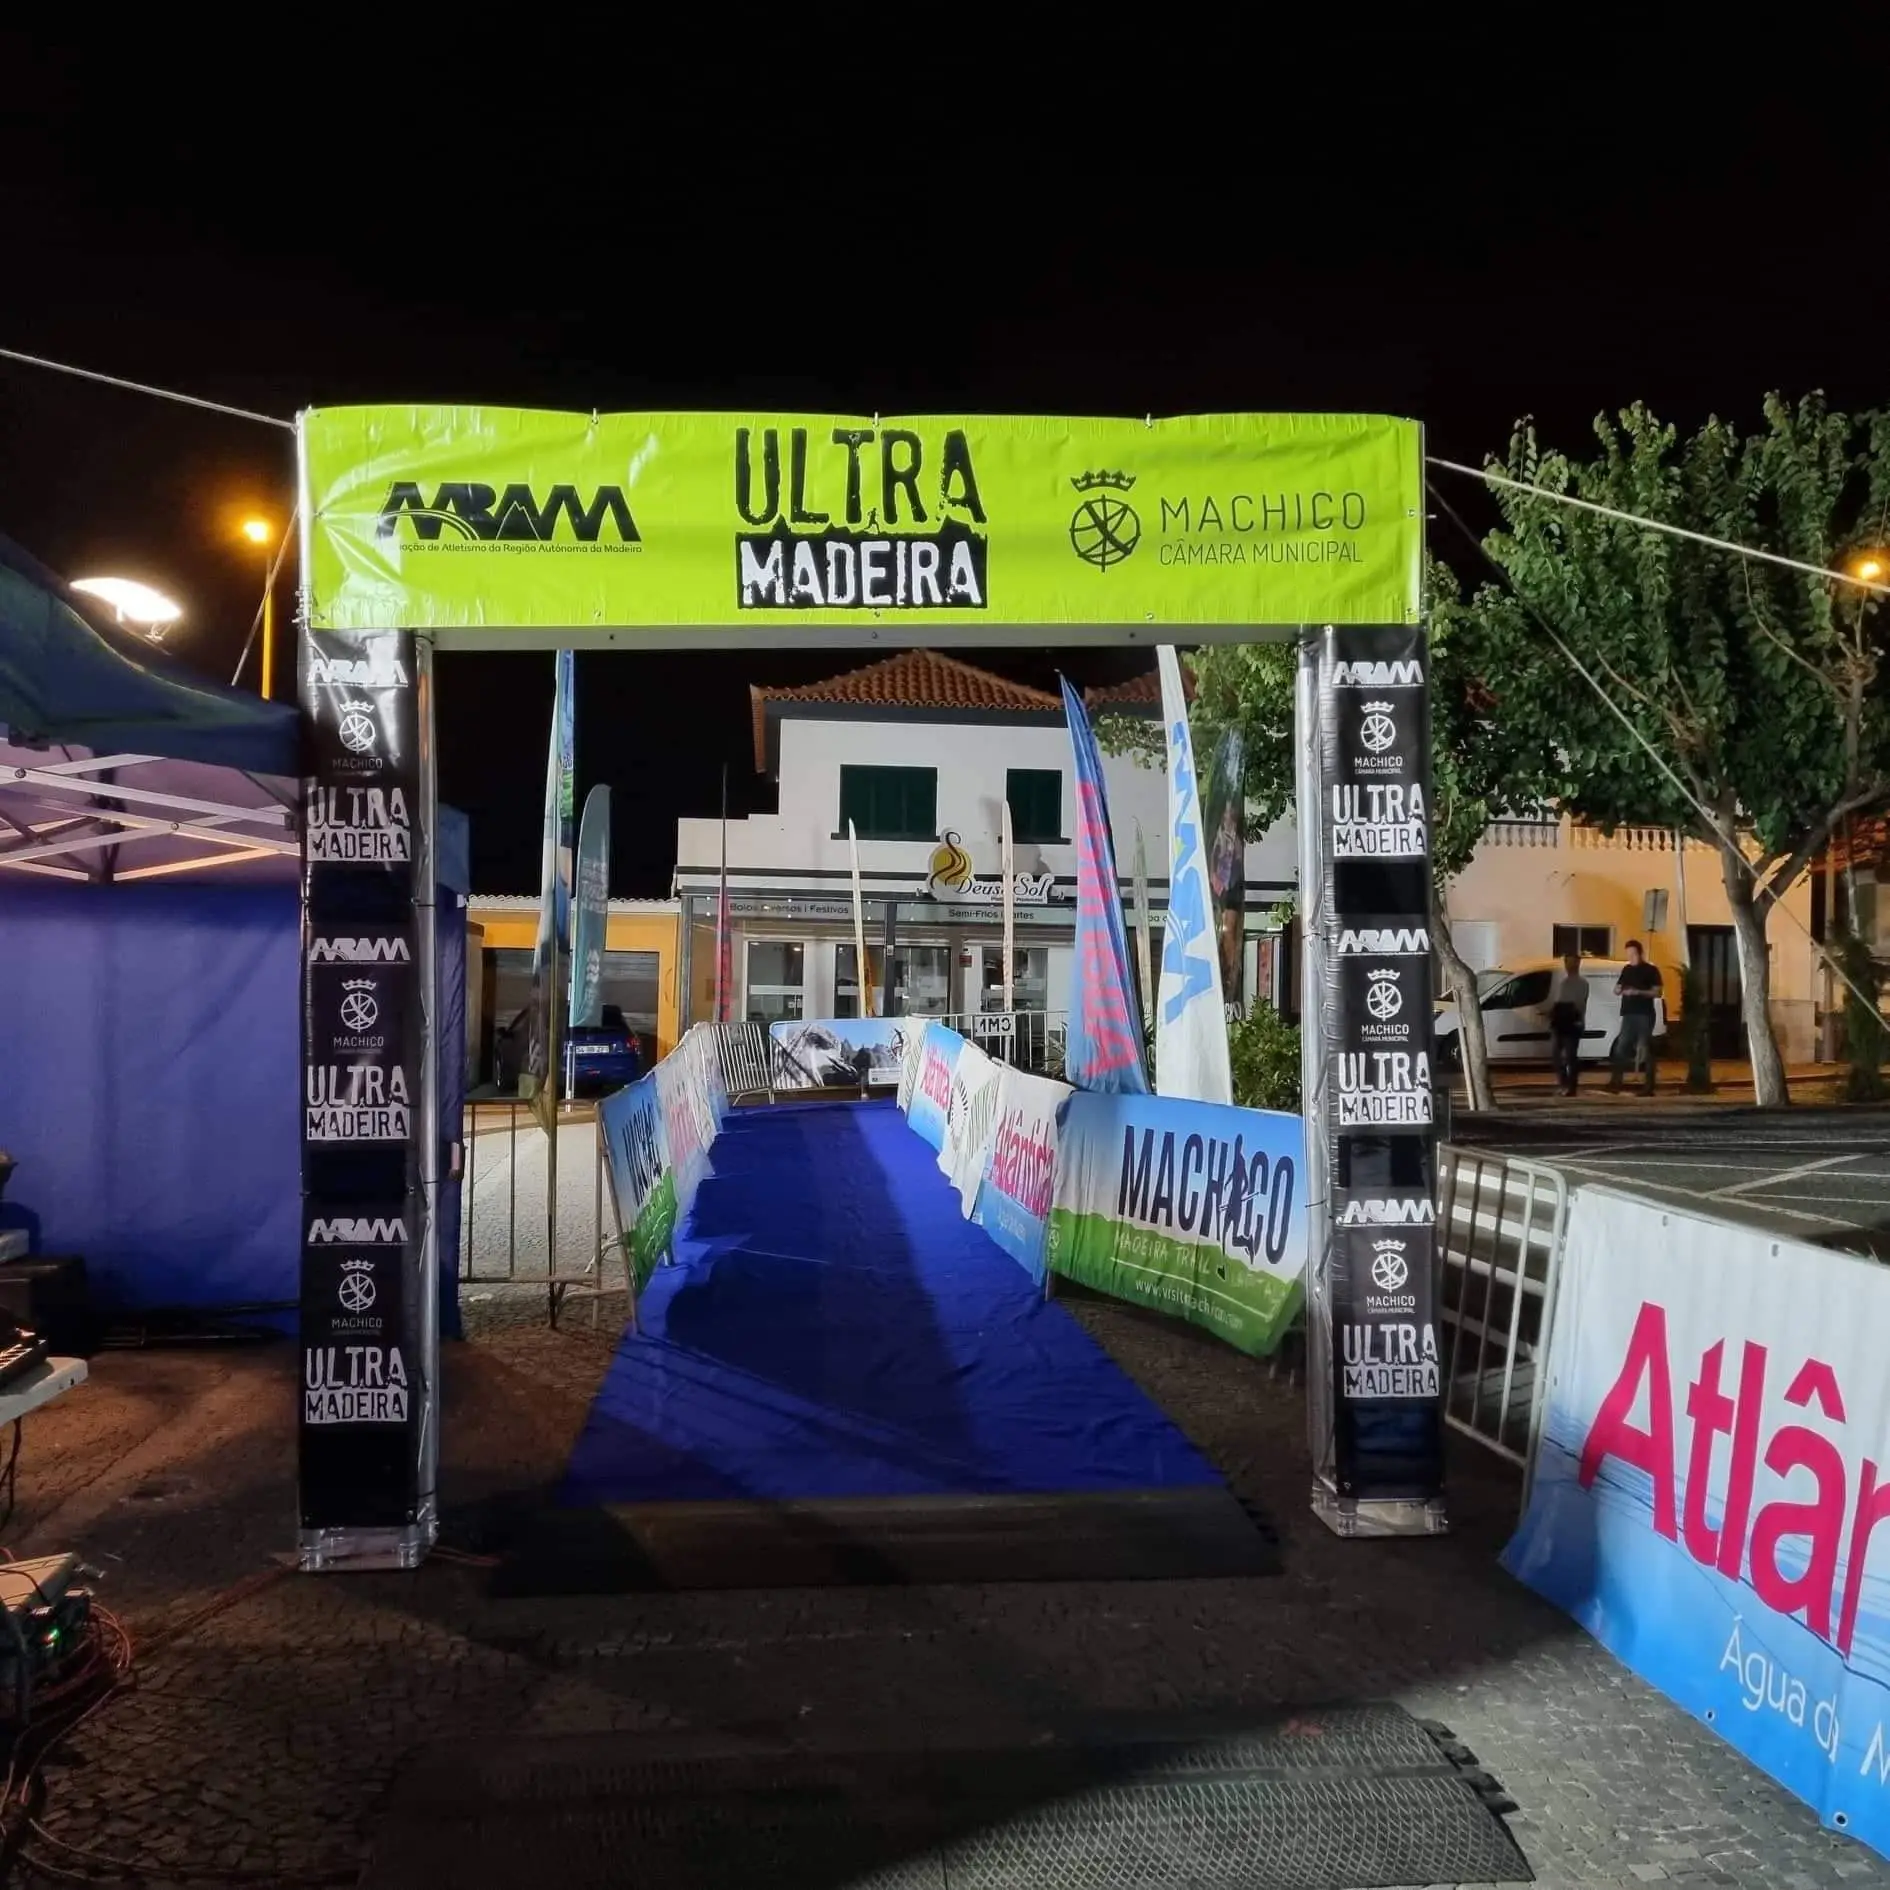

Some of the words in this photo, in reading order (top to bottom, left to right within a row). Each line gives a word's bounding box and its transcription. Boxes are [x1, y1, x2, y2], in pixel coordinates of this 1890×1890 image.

[736, 429, 987, 526] ULTRA
[1161, 492, 1365, 532] MACHICO
[427, 542, 440, 552] de
[441, 542, 487, 553] Atletismo
[488, 542, 501, 552] da
[503, 542, 537, 555] Região
[590, 542, 602, 553] da
[604, 543, 642, 553] Madeira
[1160, 537, 1245, 566] CÂMARA
[1252, 540, 1363, 564] MUNICIPAL
[740, 540, 982, 606] MADEIRA
[332, 757, 383, 770] MACHICO
[1354, 756, 1403, 768] MACHICO
[307, 786, 411, 830] ULTRA
[1332, 783, 1427, 825] ULTRA
[310, 831, 410, 860] MADEIRA
[1335, 828, 1427, 855] MADEIRA
[955, 875, 1004, 895] Deus
[1013, 876, 1053, 897] Sol
[333, 1036, 385, 1048] MACHICO
[1361, 1023, 1410, 1035] MACHICO
[307, 1064, 410, 1107] ULTRA
[1338, 1051, 1432, 1093] ULTRA
[1341, 1095, 1432, 1123] MADEIRA
[308, 1110, 409, 1138] MADEIRA
[1118, 1124, 1295, 1265] MACHICO
[1367, 1295, 1416, 1307] MACHICO
[331, 1317, 383, 1329] MACHICO
[1343, 1323, 1438, 1365] ULTRA
[306, 1346, 408, 1389] ULTRA
[1345, 1367, 1438, 1395] MADEIRA
[306, 1391, 406, 1421] MADEIRA
[1719, 1614, 1807, 1728] Água
